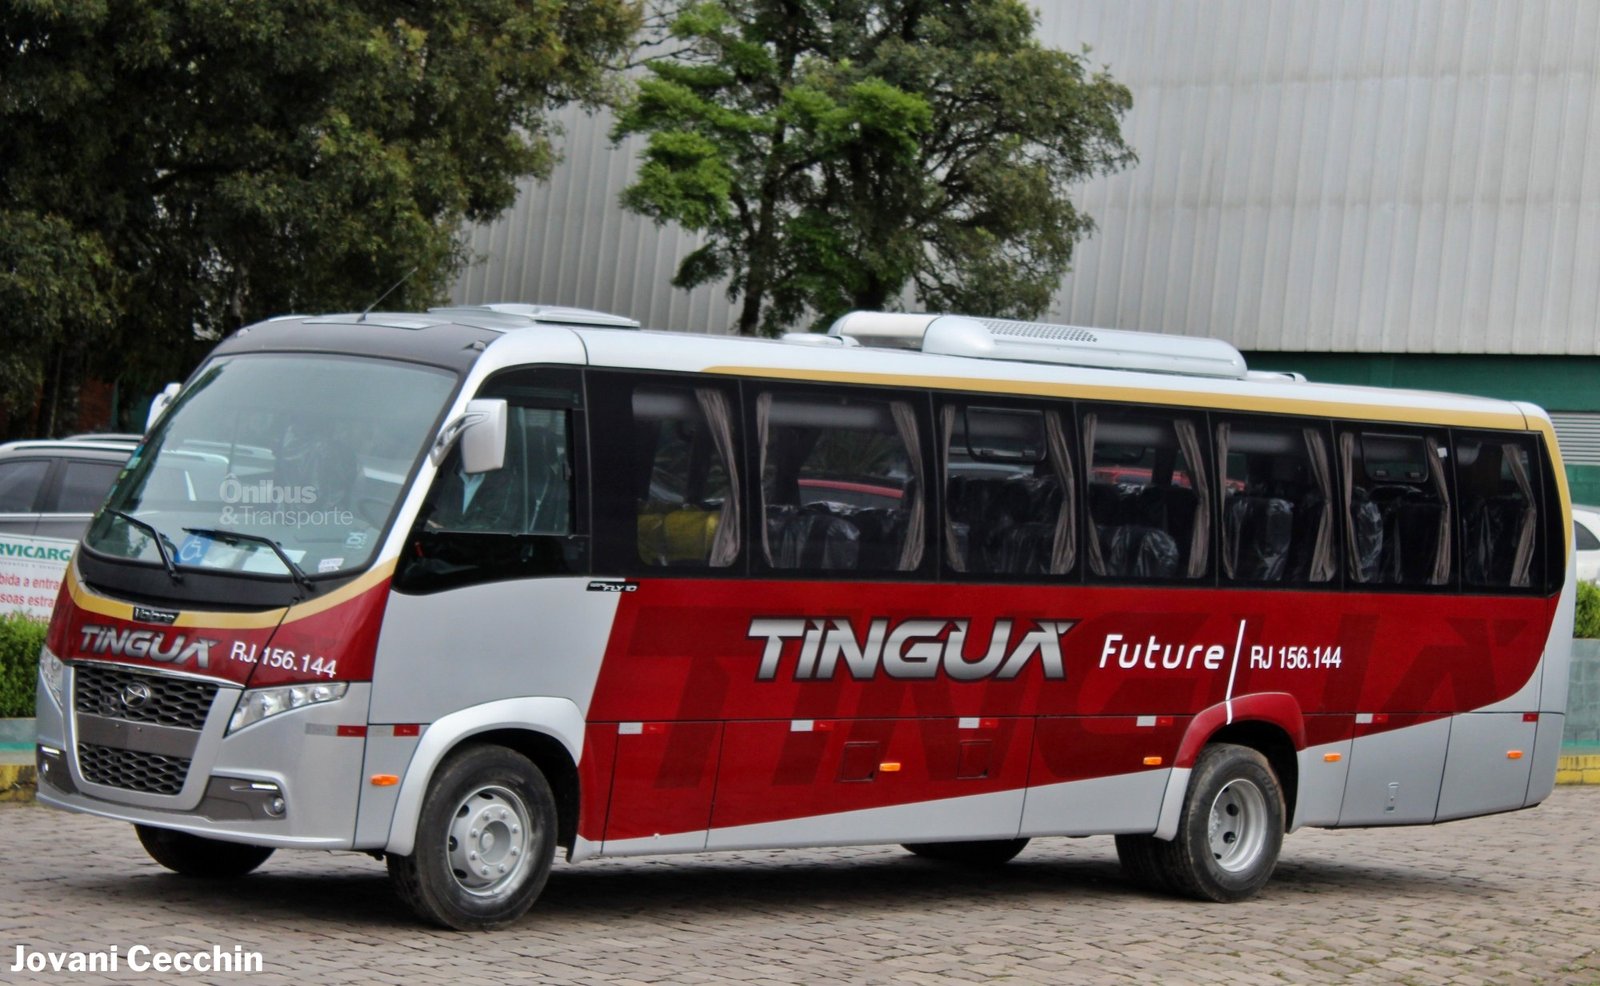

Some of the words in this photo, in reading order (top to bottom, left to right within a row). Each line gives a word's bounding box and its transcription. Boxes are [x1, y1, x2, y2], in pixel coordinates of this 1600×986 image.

[1099, 634, 1224, 669] Future
[1250, 645, 1273, 669] RJ
[1278, 646, 1342, 669] 156.144
